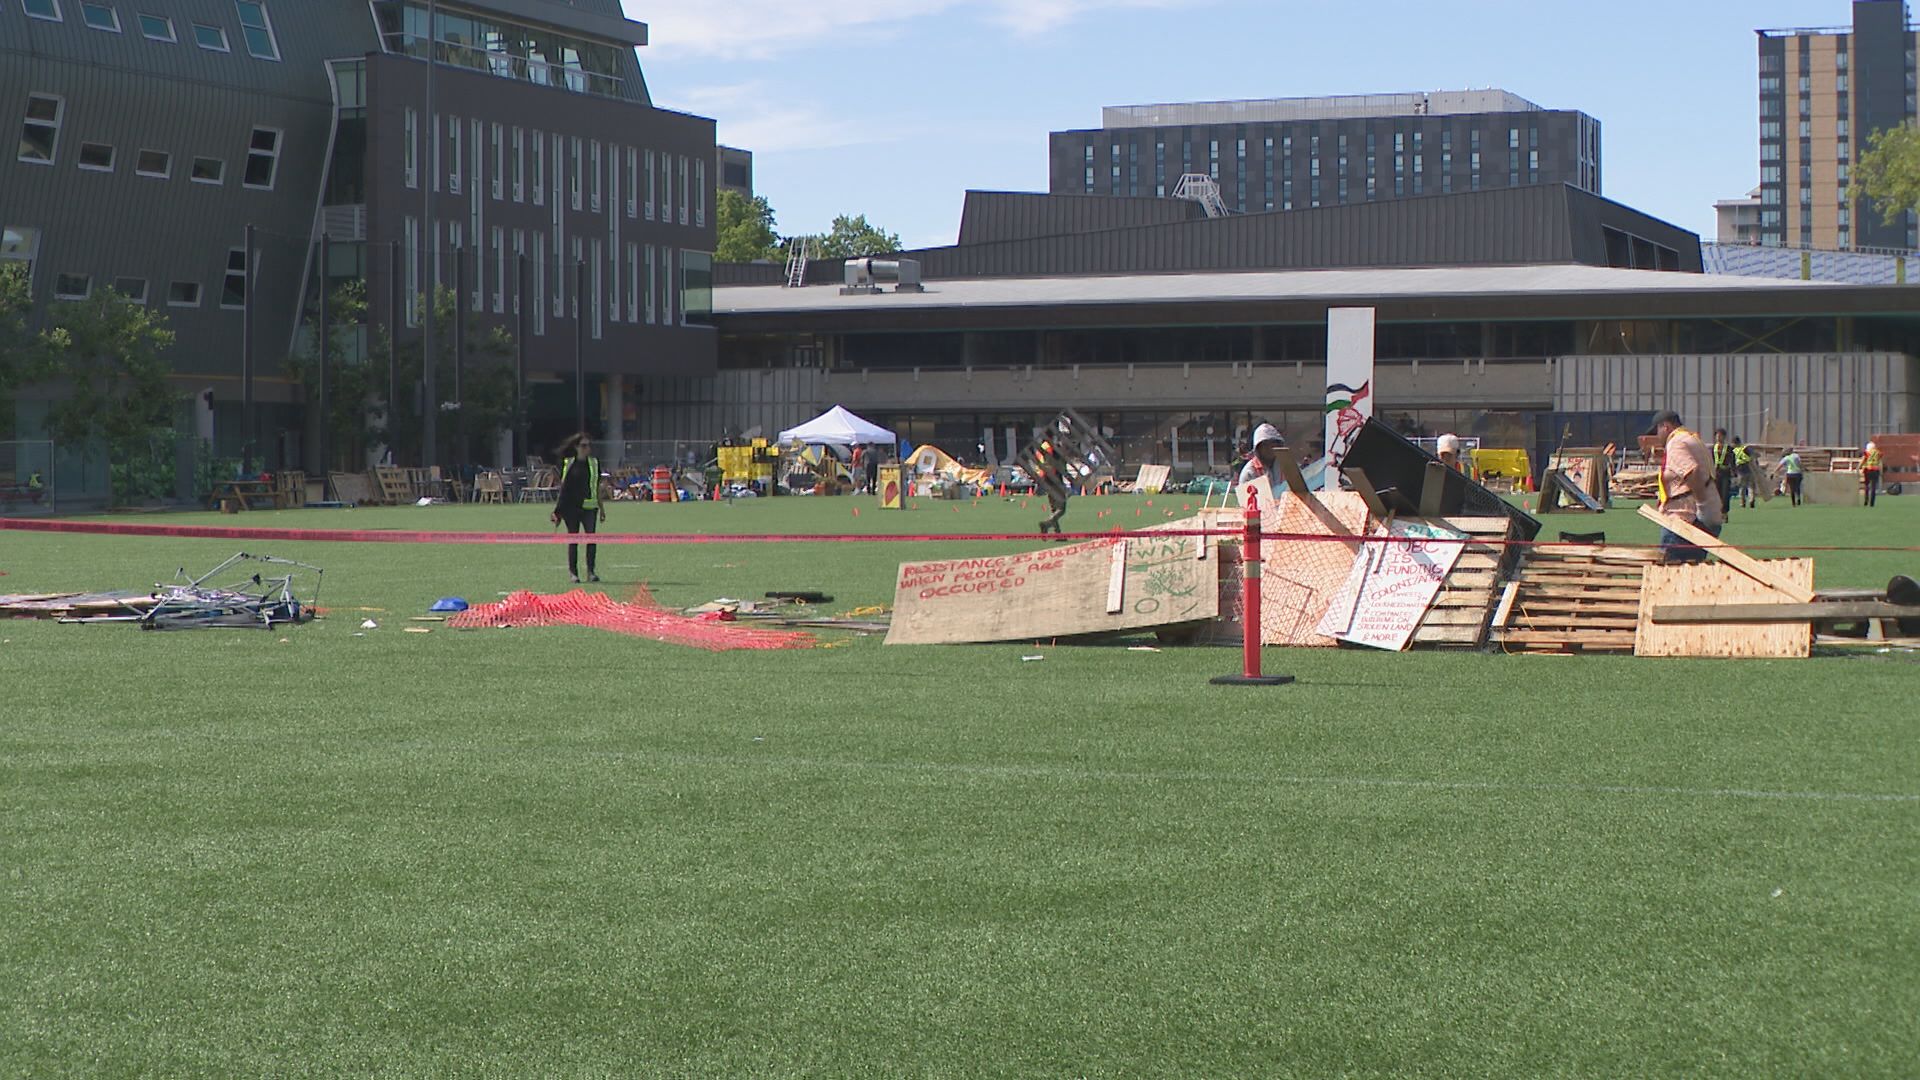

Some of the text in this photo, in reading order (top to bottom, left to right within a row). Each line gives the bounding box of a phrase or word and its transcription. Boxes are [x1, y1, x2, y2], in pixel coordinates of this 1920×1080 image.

[1136, 539, 1187, 559] WAY
[1397, 540, 1440, 554] UBC
[1391, 553, 1412, 564] IS
[900, 560, 1064, 589] WHEN PEOPLE ARE
[1386, 563, 1444, 576] FUNDING
[919, 577, 1025, 599] OCCUPIED
[1370, 633, 1398, 641] MORE
